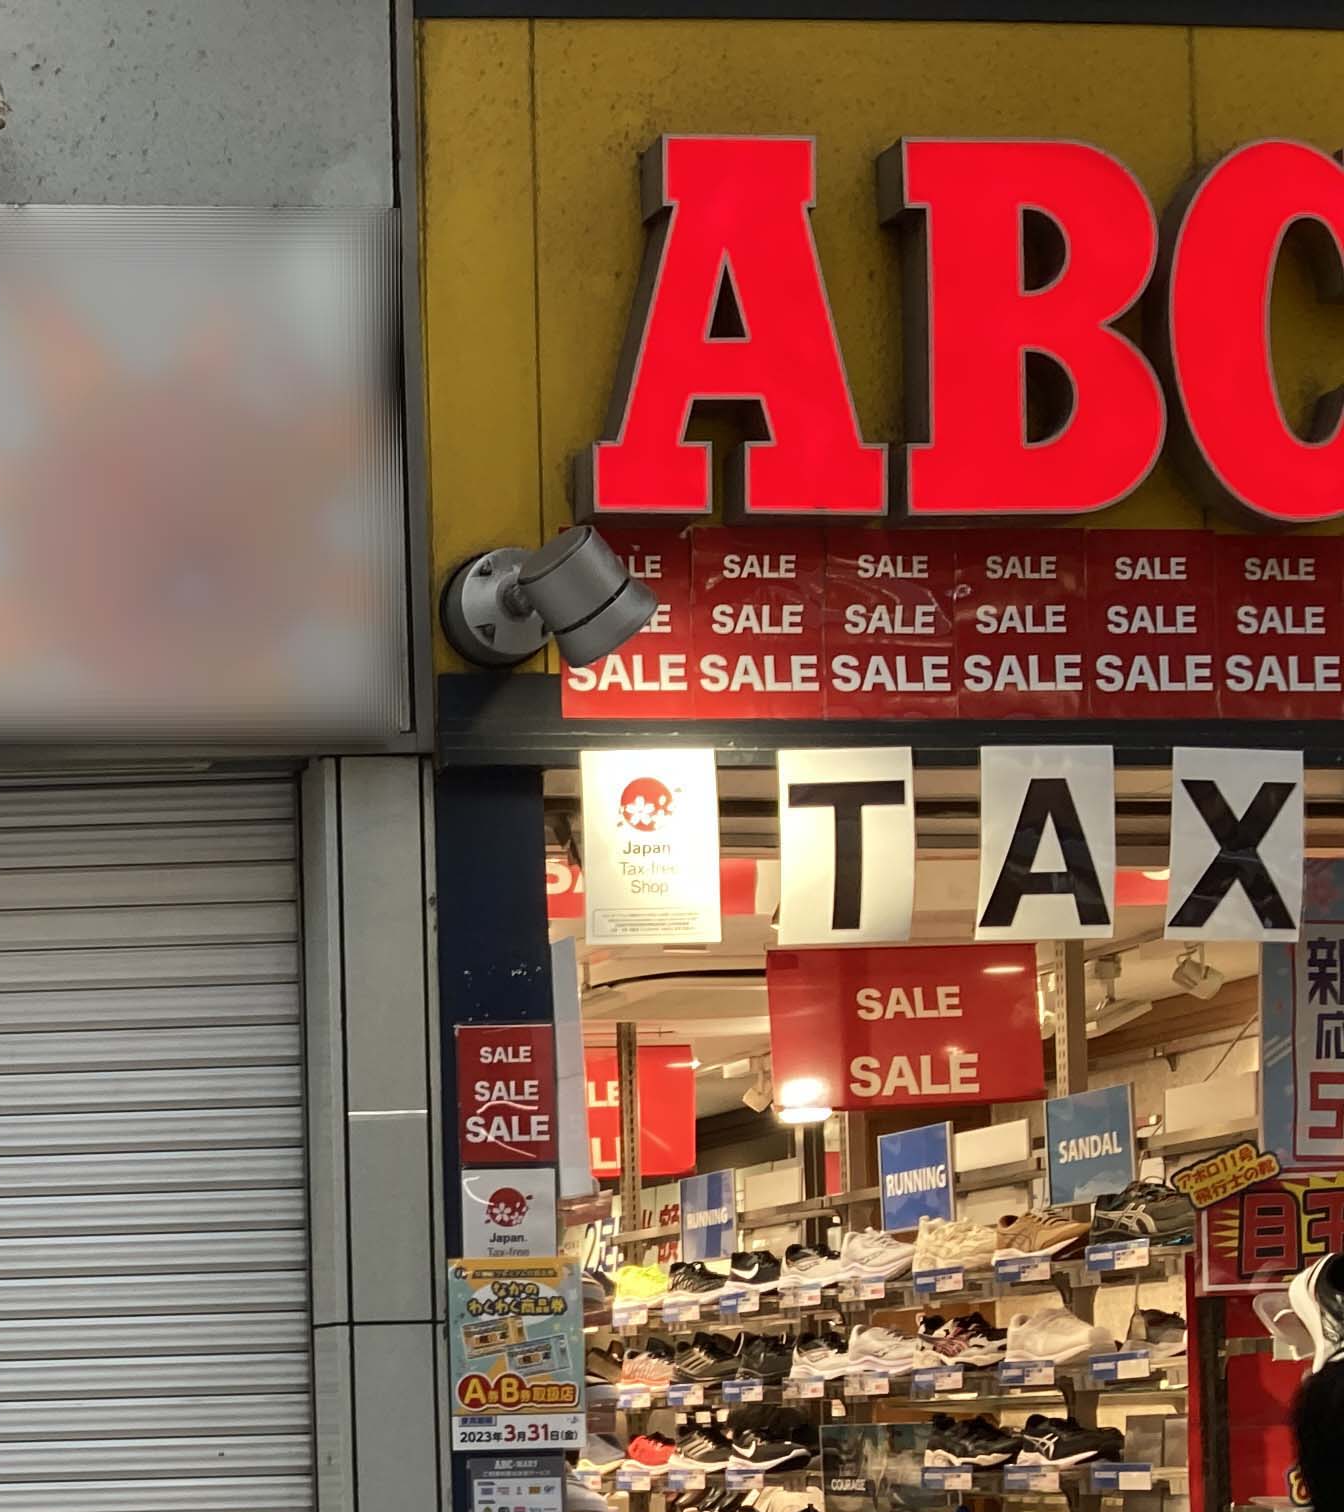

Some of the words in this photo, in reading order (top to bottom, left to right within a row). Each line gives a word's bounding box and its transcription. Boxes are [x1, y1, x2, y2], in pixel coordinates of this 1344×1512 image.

[592, 133, 1344, 523] ABC
[626, 555, 662, 579] LE
[722, 554, 797, 579] SALE
[857, 554, 929, 579] SALE
[985, 555, 1057, 580] SALE
[1115, 556, 1187, 581] SALE
[1244, 557, 1316, 581] SALE
[711, 604, 804, 635] SALE
[843, 604, 936, 635] SALE
[975, 604, 1067, 635] SALE
[1106, 605, 1197, 635] SALE
[1236, 605, 1326, 635] SALE
[567, 653, 688, 692] SALE
[699, 653, 820, 692] SALE
[831, 654, 952, 692] SALE
[963, 654, 1083, 692] SALE
[1095, 654, 1214, 692] SALE
[1225, 655, 1342, 692] SALE
[788, 778, 1299, 931] TAX
[631, 879, 670, 896] Shop
[855, 985, 963, 1020] SALE
[479, 1046, 532, 1064] SALE
[474, 1080, 539, 1102] SALE
[849, 1053, 980, 1097] SALE
[465, 1115, 550, 1143] SALE
[1058, 1131, 1122, 1164] SANDAL
[886, 1164, 947, 1197] RUNNING
[686, 1207, 729, 1231] RUNNING
